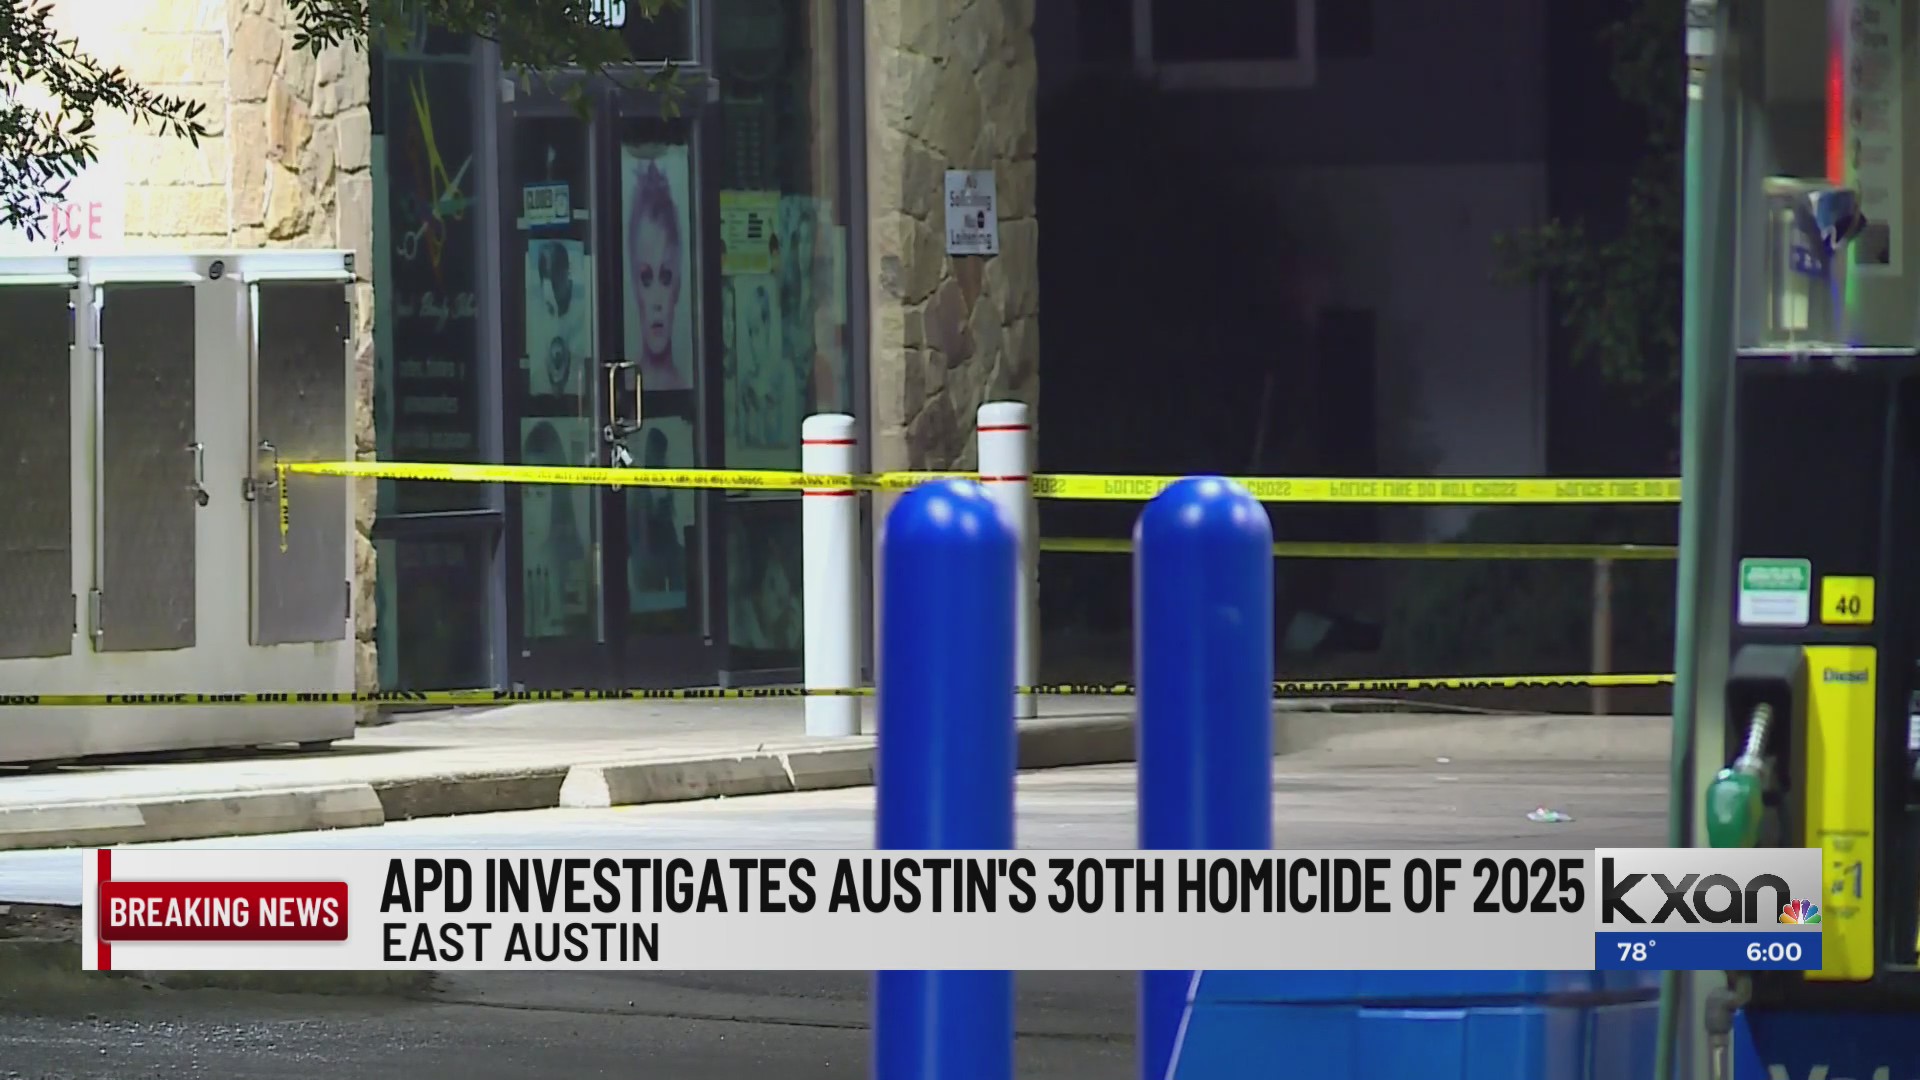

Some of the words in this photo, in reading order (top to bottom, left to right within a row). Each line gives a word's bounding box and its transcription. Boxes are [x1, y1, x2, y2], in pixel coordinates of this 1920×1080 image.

[51, 201, 103, 243] ICE
[1836, 595, 1861, 615] 40
[1824, 667, 1869, 683] Diesel
